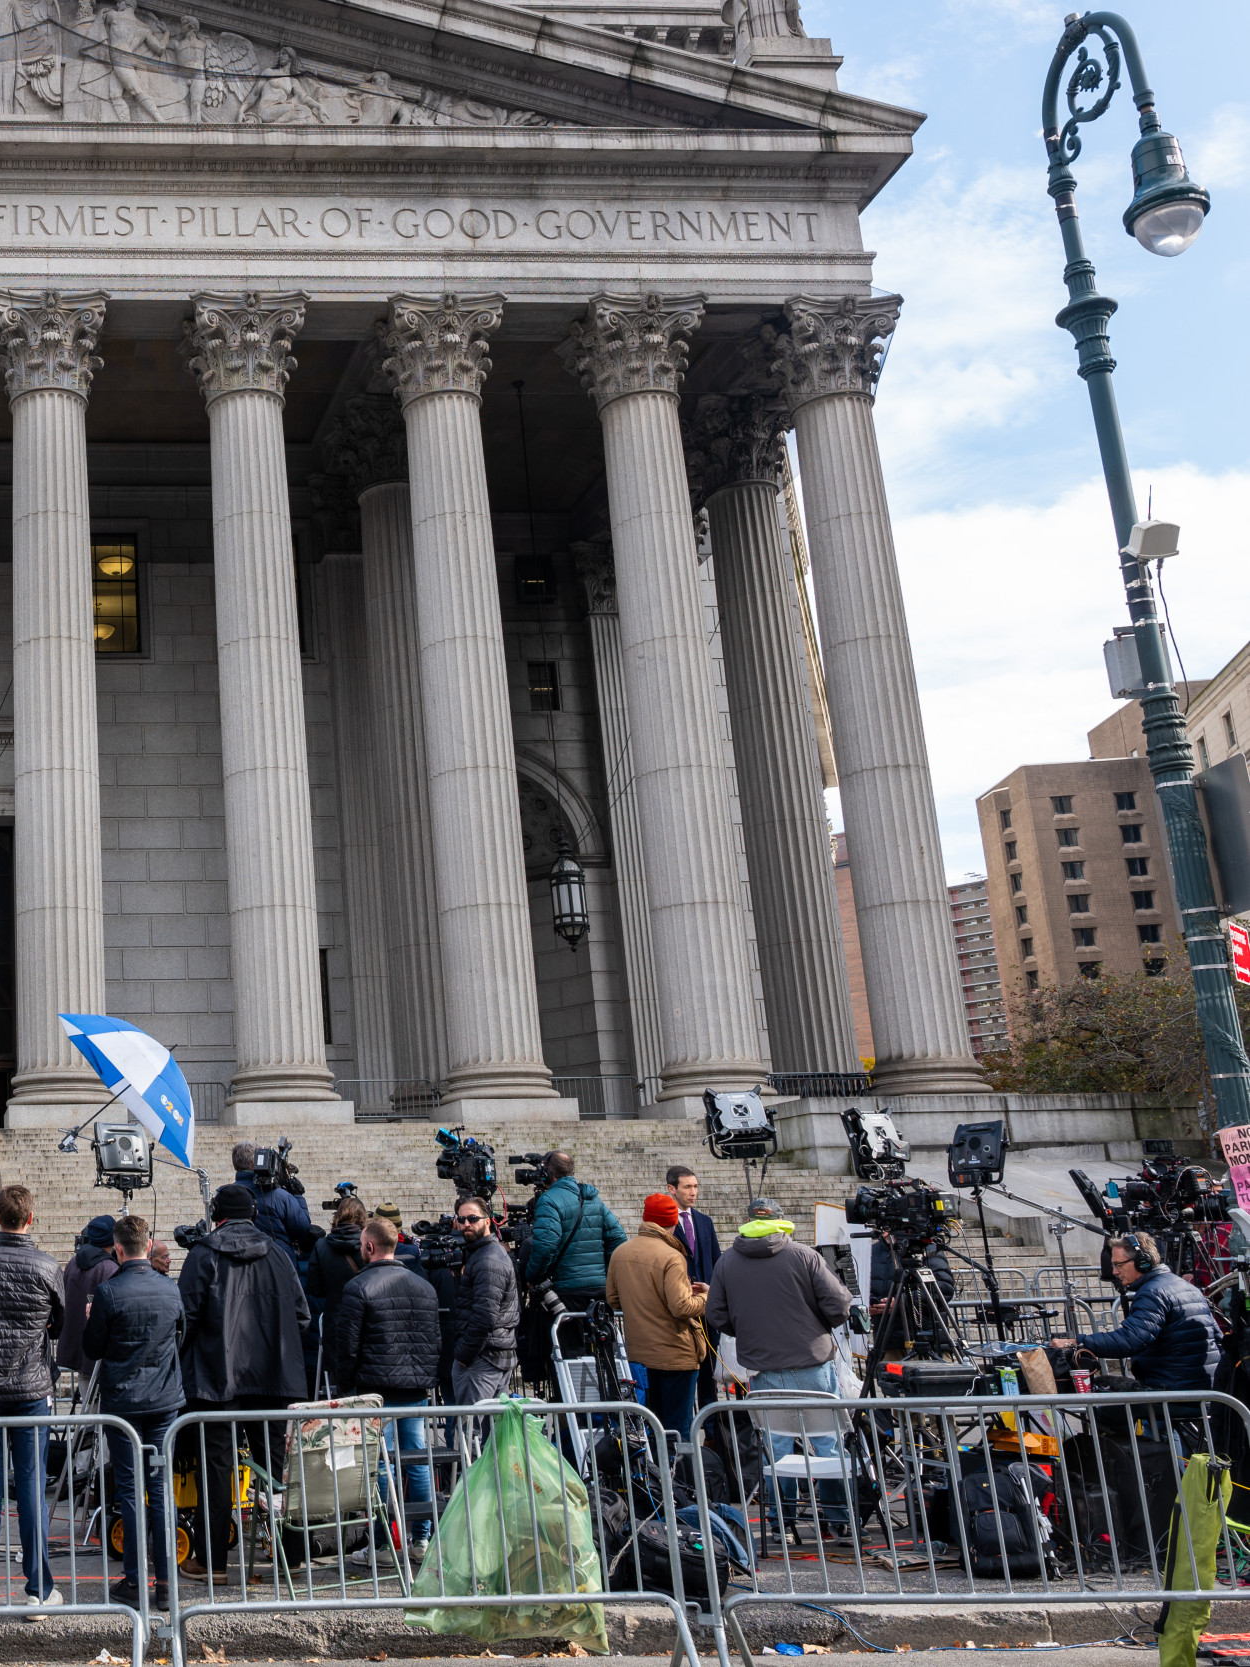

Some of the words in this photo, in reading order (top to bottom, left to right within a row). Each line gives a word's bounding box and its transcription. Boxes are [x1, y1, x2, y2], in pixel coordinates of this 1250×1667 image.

[175, 206, 308, 238] PILLAR
[318, 207, 374, 239] OF
[386, 208, 519, 241] GOOD
[535, 209, 818, 243] GOVERNMENT
[1225, 1140, 1250, 1154] PAR
